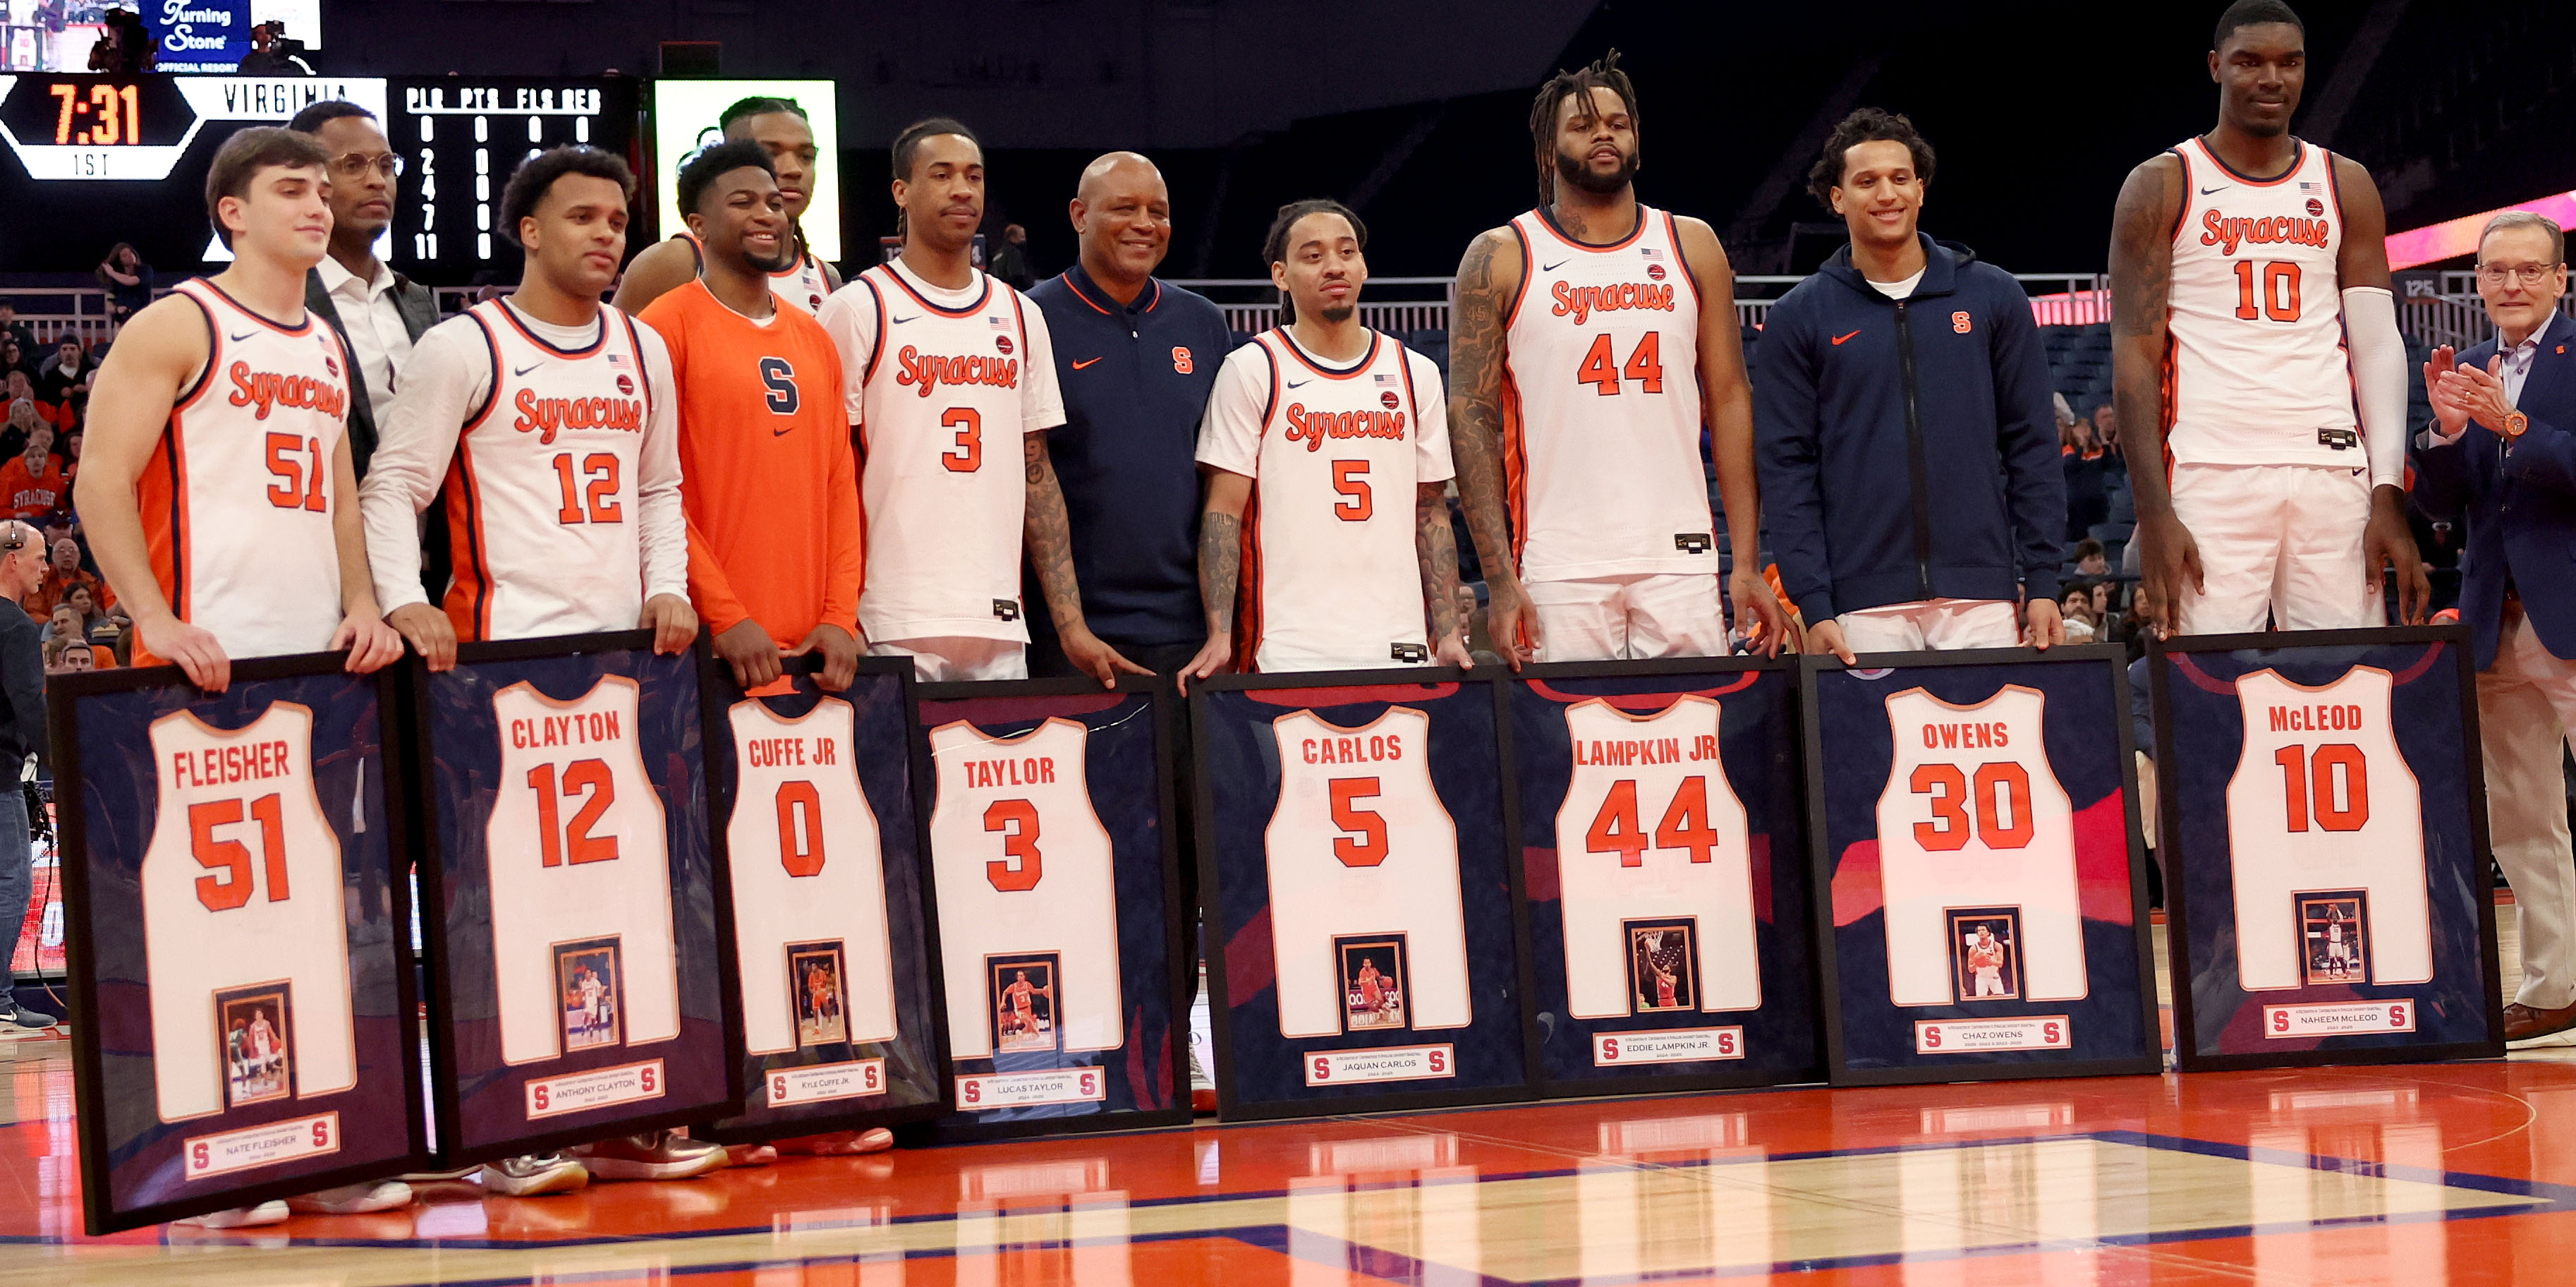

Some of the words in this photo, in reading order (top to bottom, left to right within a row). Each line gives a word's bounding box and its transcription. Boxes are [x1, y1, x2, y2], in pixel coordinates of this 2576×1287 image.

[159, 0, 231, 26] Turning
[200, 64, 238, 73] RESORT
[224, 84, 346, 113] VIRGINIA
[461, 88, 499, 110] PTS
[517, 88, 554, 110] FLS
[50, 83, 140, 145] 7:31
[73, 153, 109, 176] 1ST
[420, 148, 434, 175] 2
[421, 174, 436, 201] 4
[423, 204, 435, 231] 7
[2200, 205, 2329, 256] Syracuse
[415, 234, 437, 260] 11
[1552, 277, 1675, 326] Syracuse
[2234, 259, 2302, 322] 10
[1952, 311, 1973, 334] S
[897, 342, 1018, 399] Syracuse
[1172, 346, 1195, 375] S
[1577, 330, 1663, 397] 44
[228, 358, 346, 423] Syracuse
[759, 356, 800, 415] S
[514, 387, 643, 445] Syracuse
[1285, 399, 1406, 452] Syracuse
[941, 406, 983, 473] 3
[265, 431, 327, 513] 51
[552, 452, 624, 525] 12
[1331, 459, 1373, 522] 5
[511, 710, 621, 749] CLAYTON
[2268, 704, 2362, 732] McLEOD
[1922, 722, 2009, 749] OWENS
[748, 737, 806, 768] CUFFE
[812, 737, 837, 766] JR
[1302, 735, 1402, 765] CARLOS
[1576, 737, 1680, 766] LAMPKIN
[1689, 735, 1717, 762] JR
[174, 739, 291, 790] FLEISHER
[963, 756, 1056, 789] TAYLOR
[2275, 743, 2370, 833] 10
[526, 757, 620, 869] 12
[1909, 761, 2035, 853] 30
[775, 780, 826, 878] 0
[1328, 776, 1390, 868] 5
[1585, 775, 1719, 869] 44
[187, 792, 291, 914] 51
[983, 798, 1043, 893] 3
[2273, 1010, 2290, 1032] S
[2301, 1015, 2339, 1025] NAHEEM
[2340, 1013, 2378, 1022] McLEOD
[2389, 1005, 2406, 1027] S
[1627, 1044, 1654, 1052] EDDIE
[1655, 1042, 1696, 1051] LAMPKIN
[1696, 1041, 1711, 1049] JR.
[1718, 1032, 1734, 1054] S
[1925, 1026, 1942, 1048] S
[1962, 1032, 1988, 1040] CHAZ
[1988, 1030, 2023, 1039] OWENS
[2043, 1022, 2060, 1044] S
[1428, 1050, 1446, 1073] S
[1603, 1038, 1620, 1061] S
[864, 1065, 878, 1089] S
[1313, 1058, 1331, 1080] S
[1342, 1062, 1379, 1071] JAQUAN
[1380, 1060, 1417, 1068] CARLOS
[555, 1086, 595, 1100] ANTHONY
[597, 1078, 636, 1092] CLAYTON
[640, 1066, 656, 1093] S
[773, 1075, 787, 1100] S
[801, 1081, 818, 1089] KYLE
[819, 1078, 840, 1087] CUFFE
[964, 1080, 981, 1104] S
[997, 1084, 1028, 1094] LUCAS
[1028, 1082, 1064, 1092] TAYLOR
[1080, 1072, 1096, 1096] S
[533, 1084, 550, 1111] S
[226, 1143, 251, 1156] NATE
[252, 1135, 297, 1151] FLEISHER
[311, 1120, 329, 1147] S
[193, 1142, 210, 1170] S
